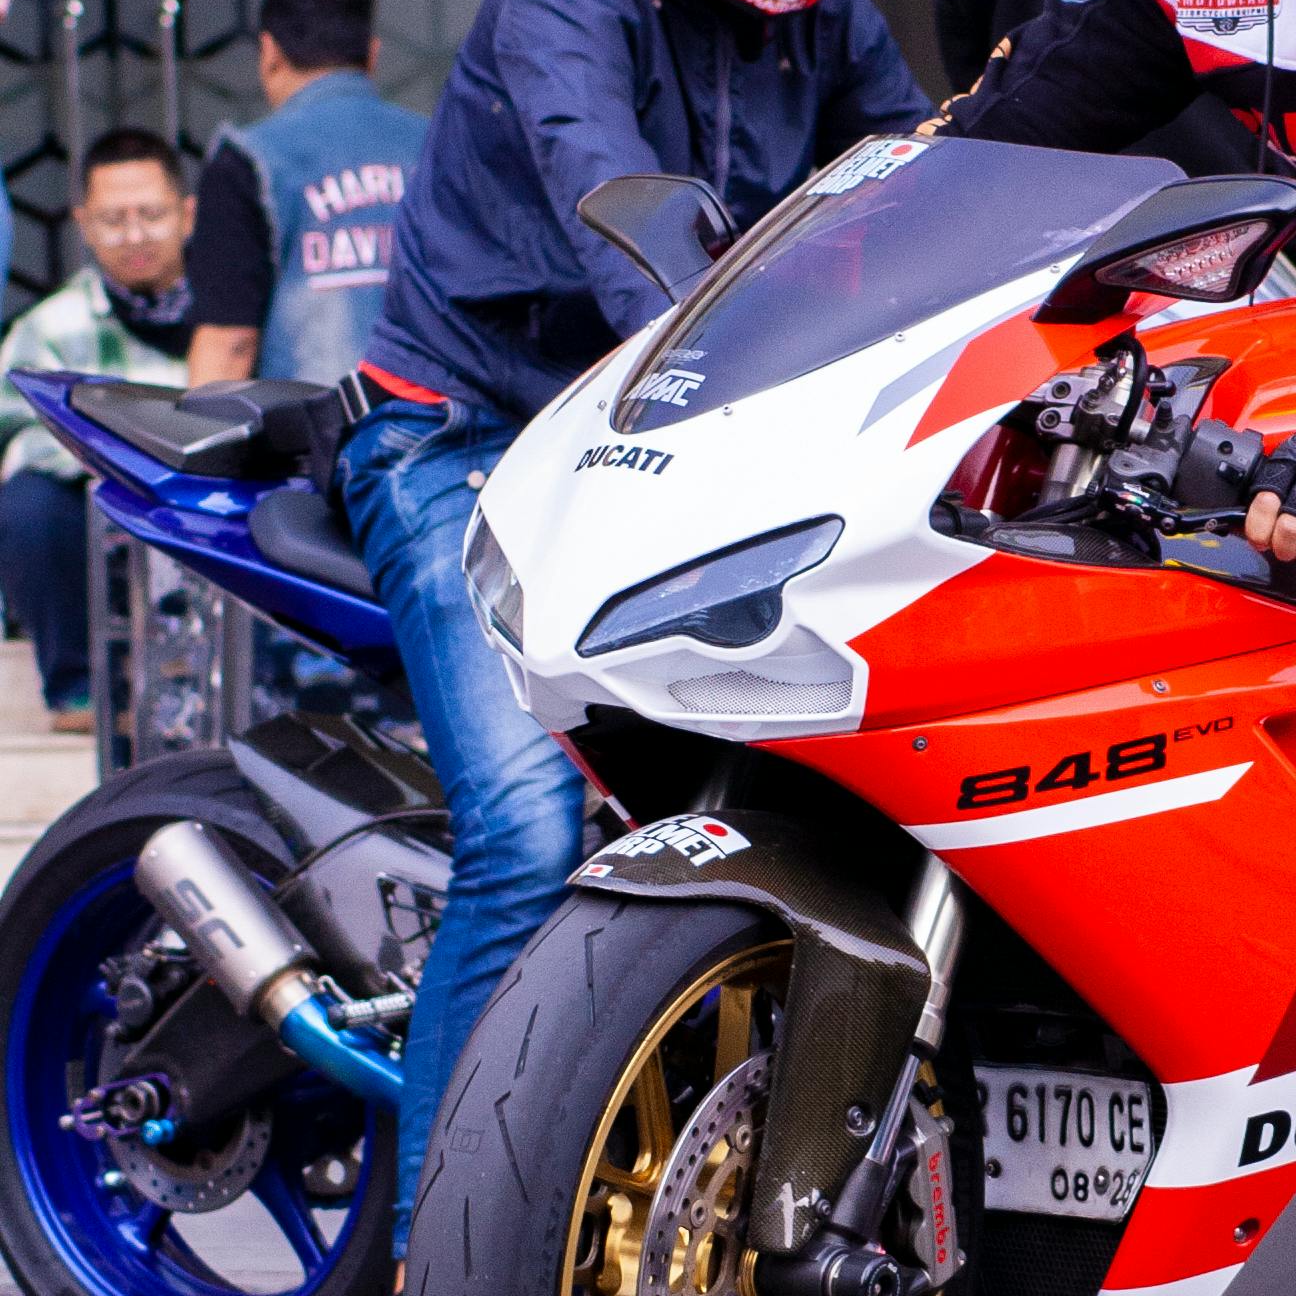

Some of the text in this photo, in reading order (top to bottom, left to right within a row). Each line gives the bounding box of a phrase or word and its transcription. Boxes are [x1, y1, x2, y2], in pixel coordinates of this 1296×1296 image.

[574, 444, 675, 475] DUCATI
[956, 716, 1234, 810] 848 EVO
[1006, 1082, 1095, 1148] 6170
[1108, 1091, 1145, 1154] CE
[927, 1151, 950, 1264] brembo
[1051, 1167, 1089, 1202] 08
